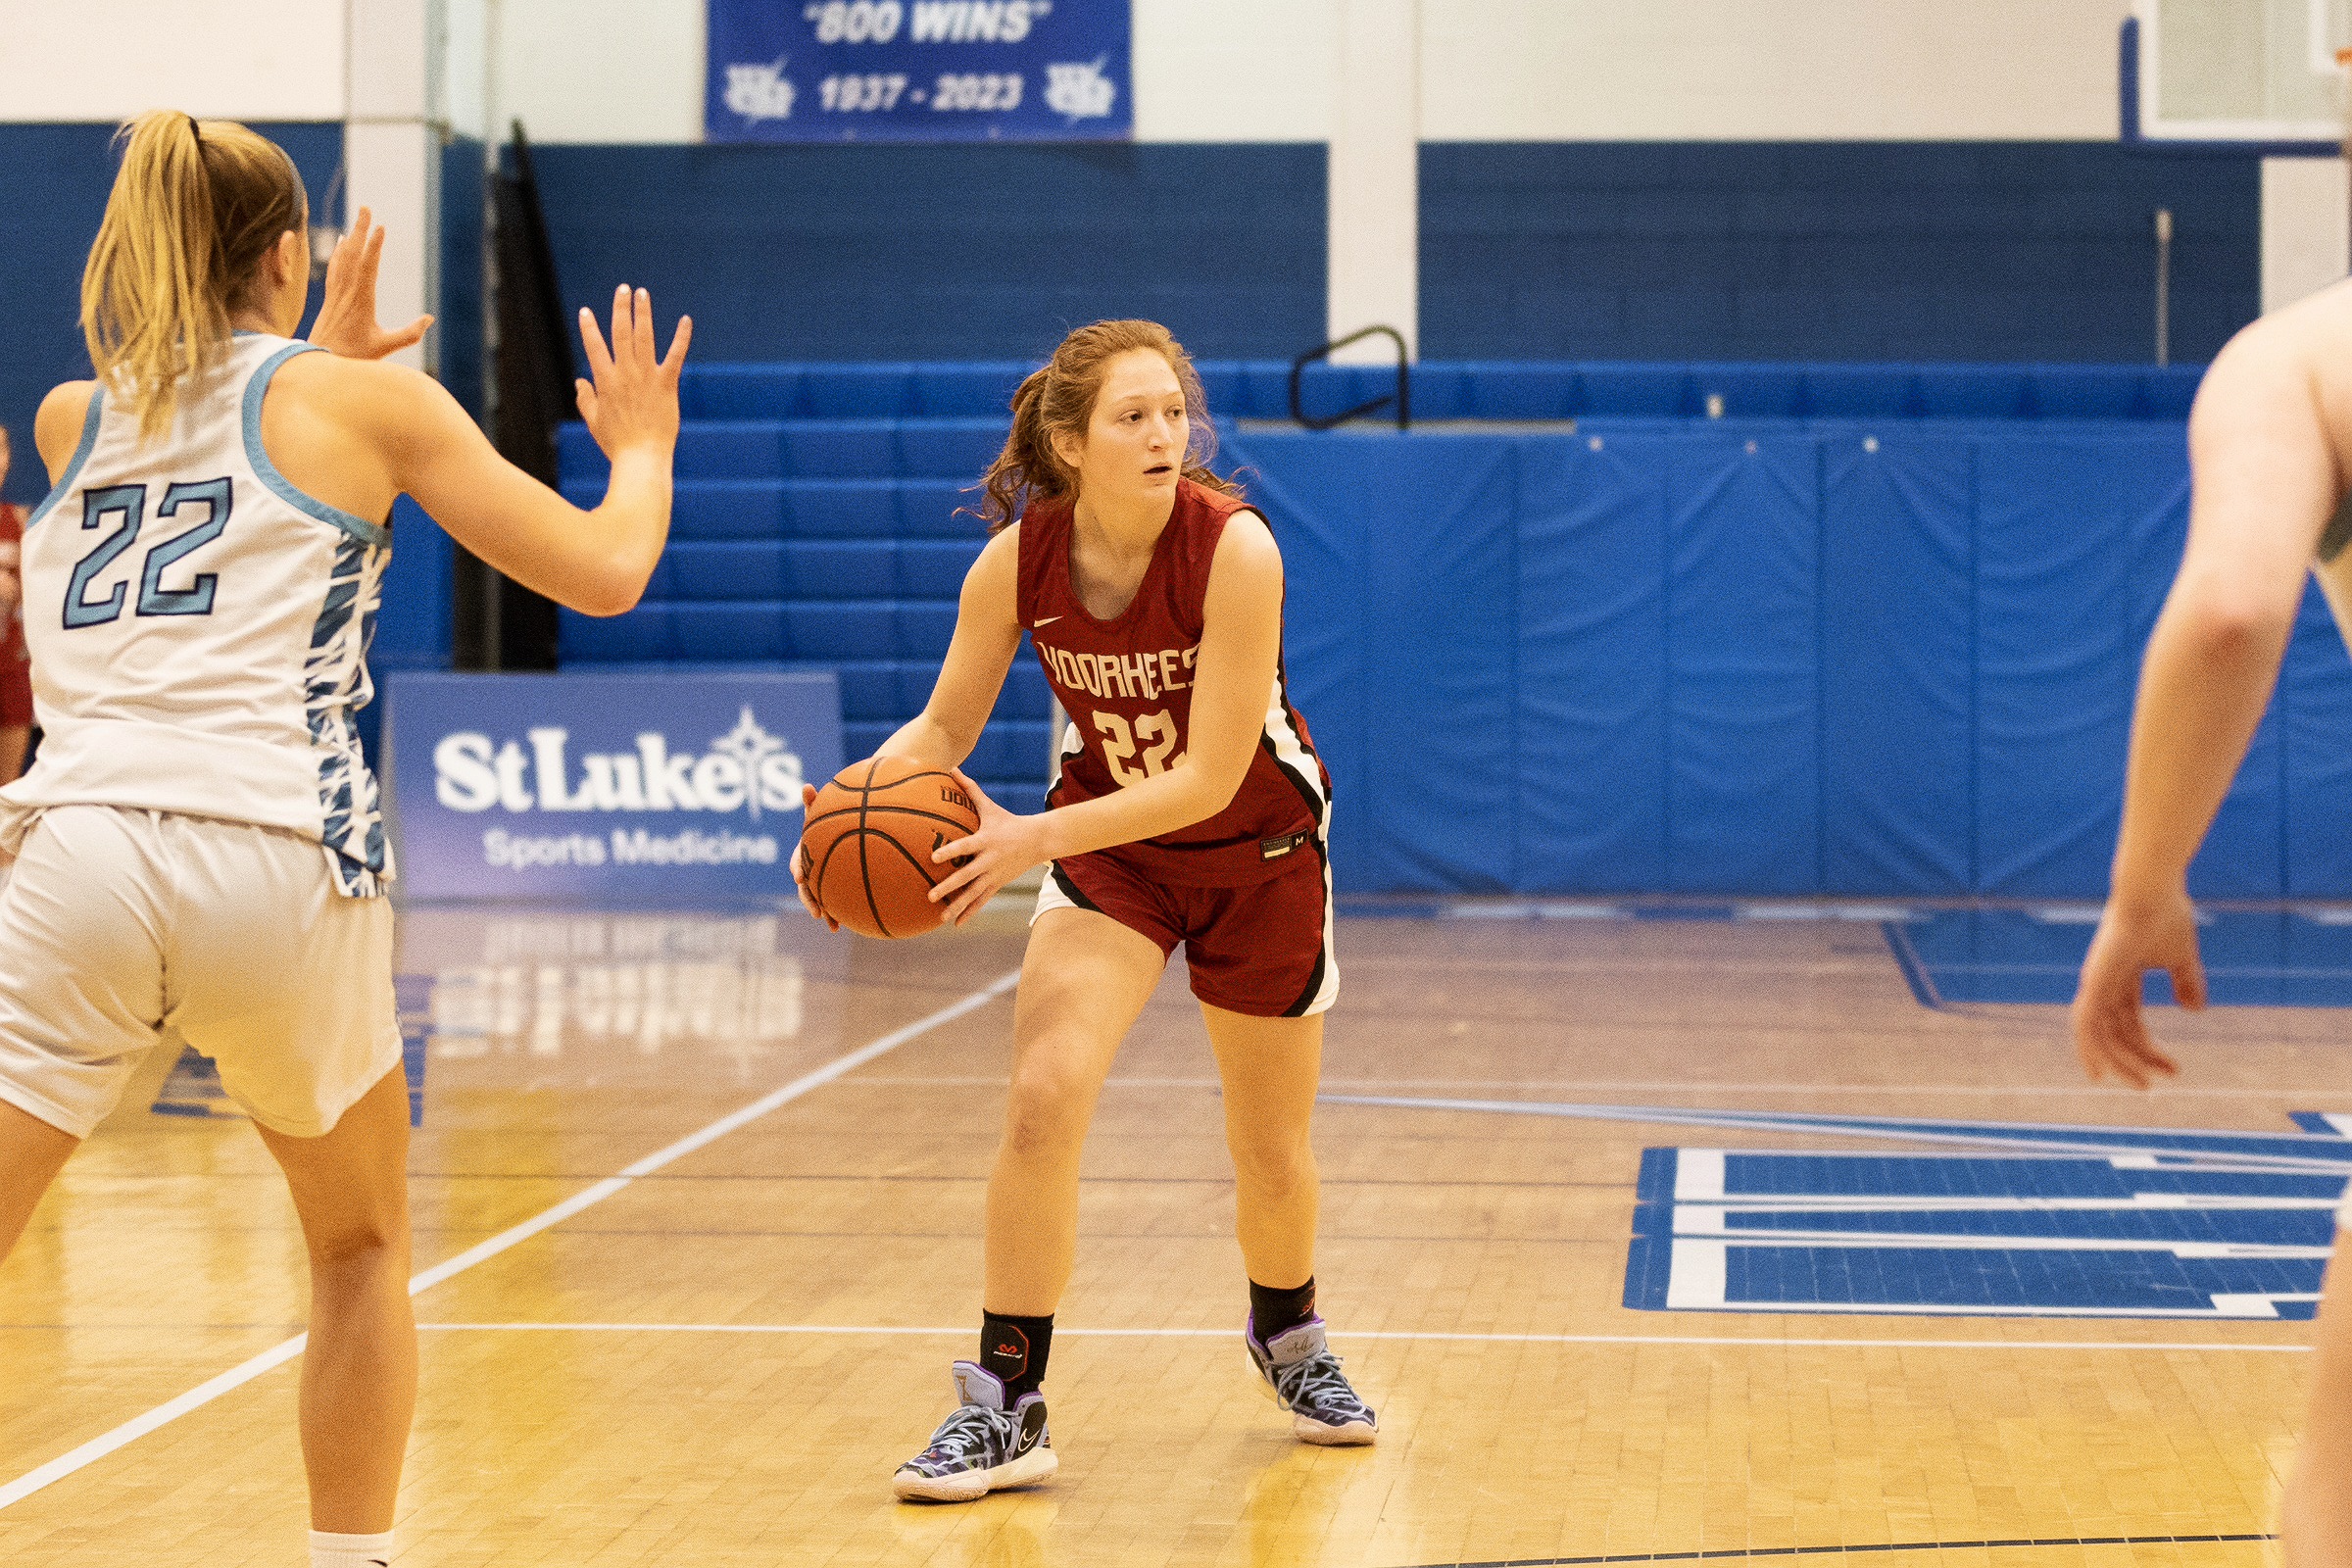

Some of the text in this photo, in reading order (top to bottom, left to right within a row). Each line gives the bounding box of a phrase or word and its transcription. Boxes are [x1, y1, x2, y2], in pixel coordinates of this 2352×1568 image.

[819, 74, 907, 111] 1937
[930, 74, 1024, 111] 2023
[63, 476, 234, 629] 22
[1092, 709, 1189, 787] 22
[484, 829, 779, 871] Sports Medicine
